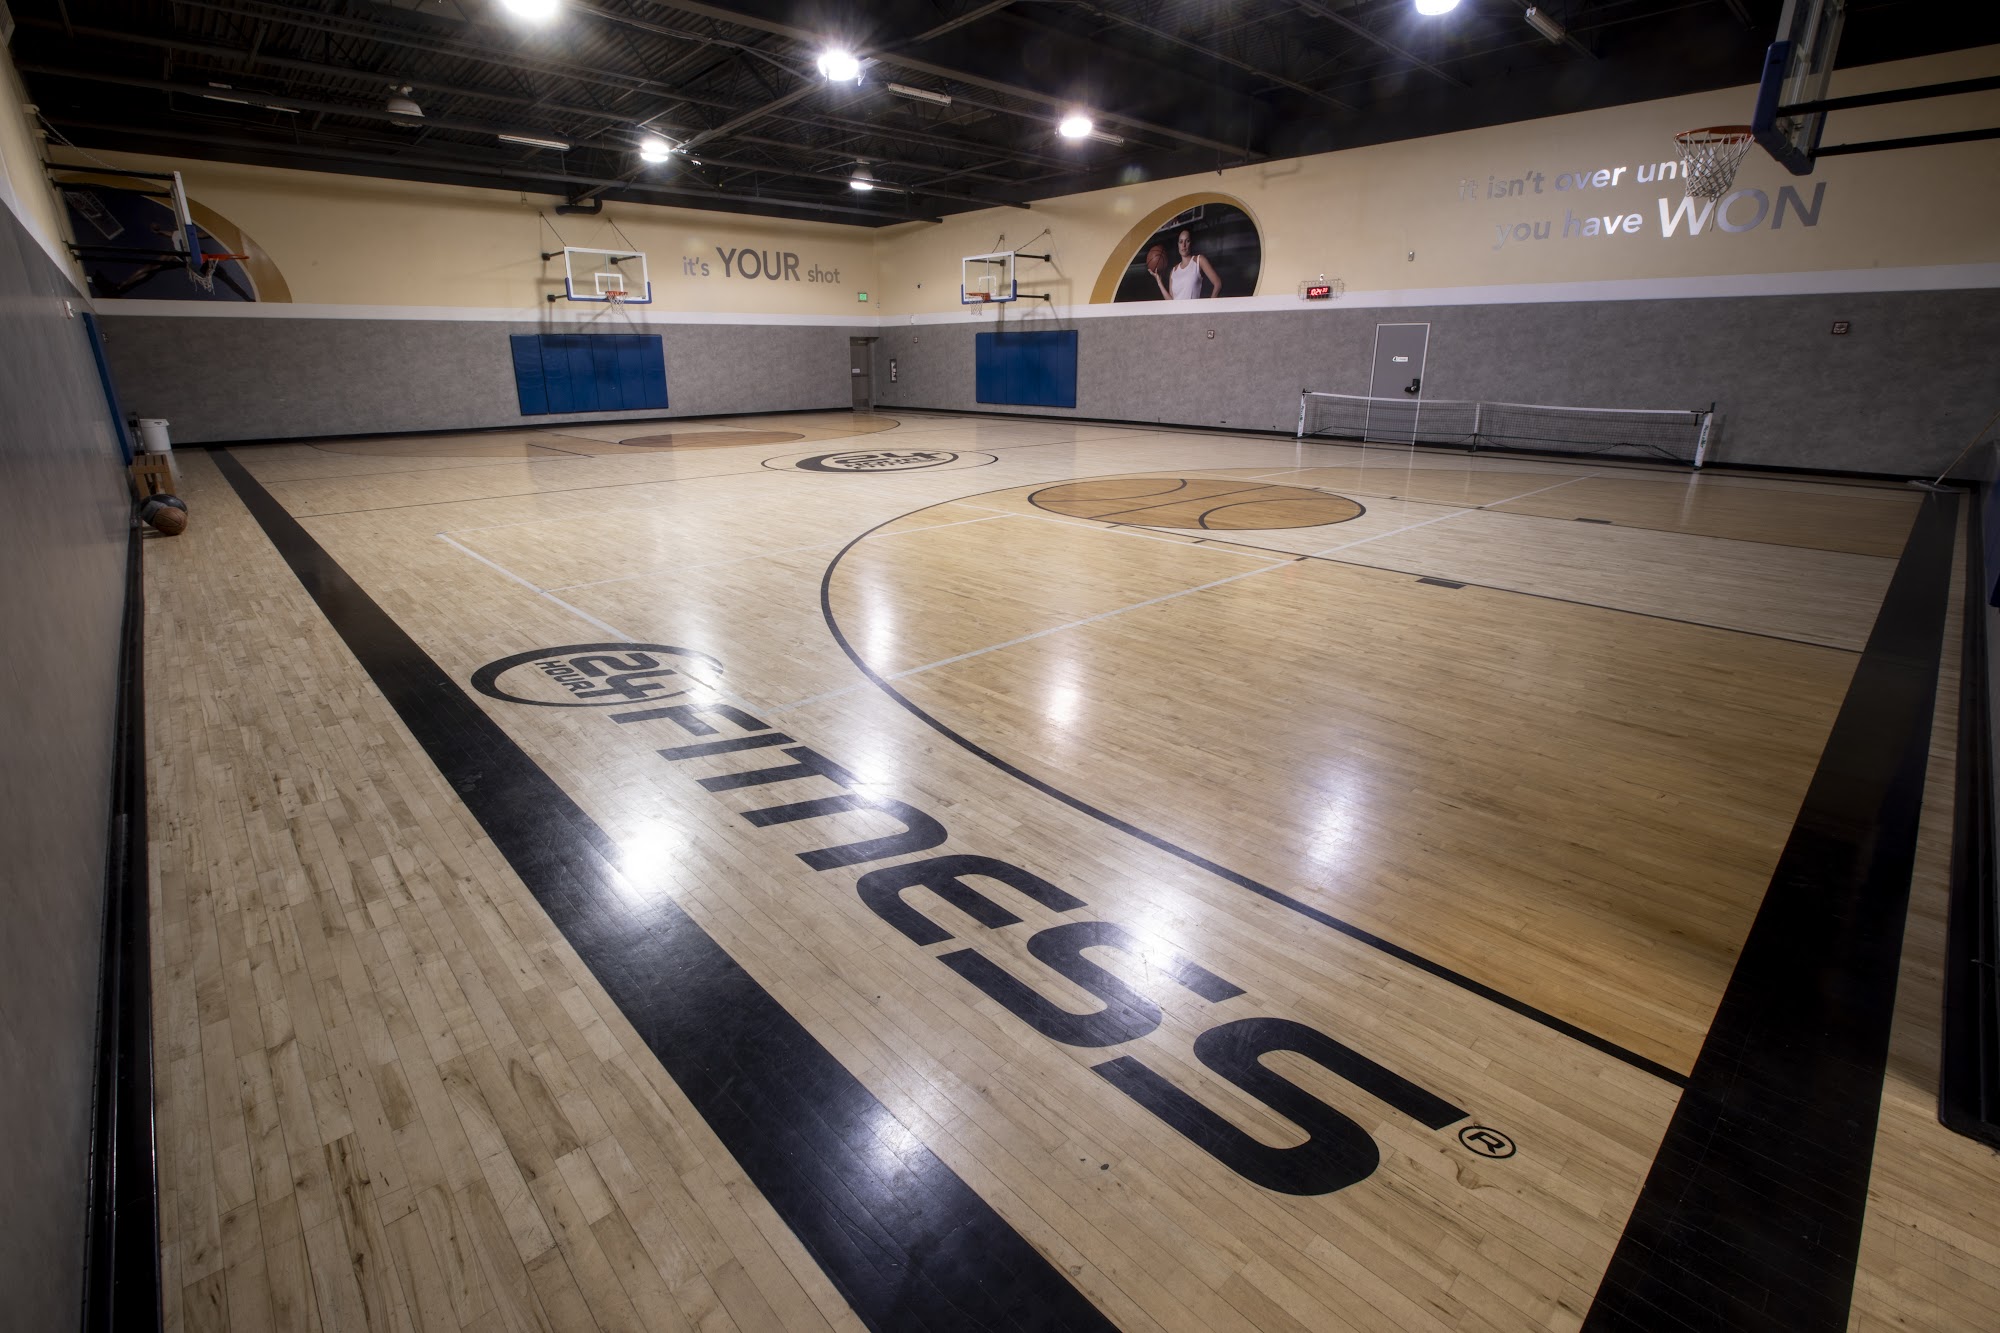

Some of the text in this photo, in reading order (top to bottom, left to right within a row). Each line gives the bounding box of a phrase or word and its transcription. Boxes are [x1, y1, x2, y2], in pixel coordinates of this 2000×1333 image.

[1458, 178, 1479, 201] it
[1487, 170, 1545, 200] isn't
[1555, 166, 1627, 192] over
[1492, 181, 1827, 251] you have WON
[682, 246, 841, 284] it's YOUR shot
[534, 659, 596, 693] HOUR
[568, 652, 679, 700] 24
